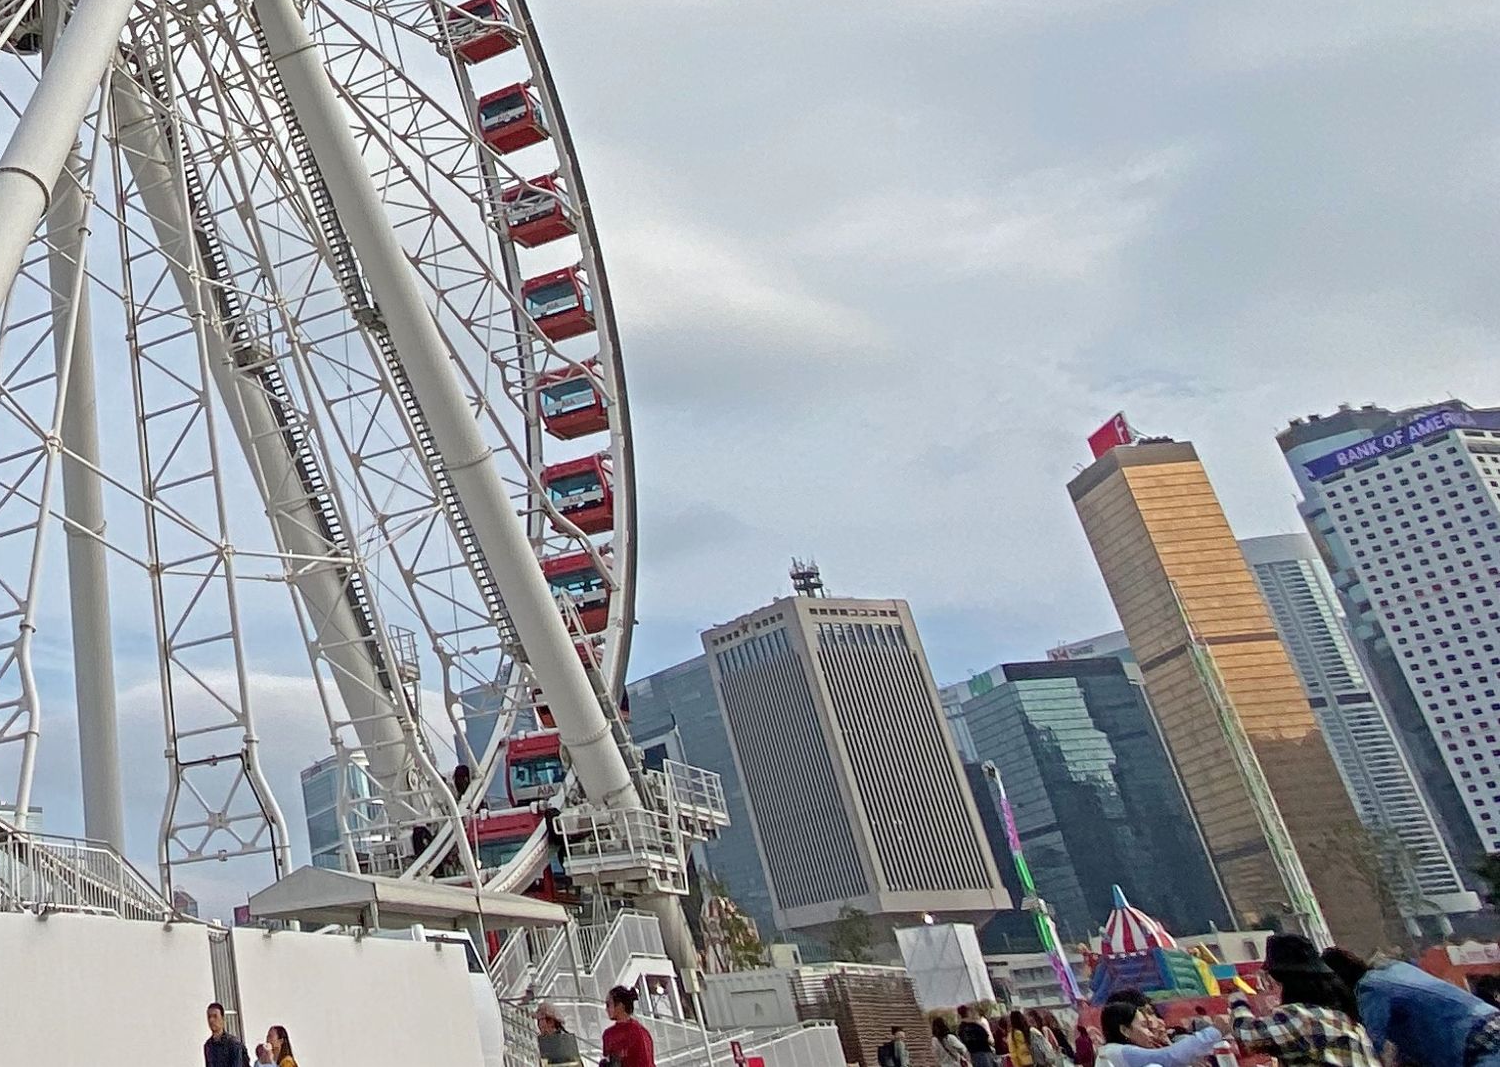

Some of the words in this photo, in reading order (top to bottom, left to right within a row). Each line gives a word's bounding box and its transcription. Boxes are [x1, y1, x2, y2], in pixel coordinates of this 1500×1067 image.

[1336, 439, 1382, 466] BANK
[1383, 432, 1404, 449] OF
[1408, 410, 1477, 441] AMERICA
[537, 785, 555, 796] AIA
